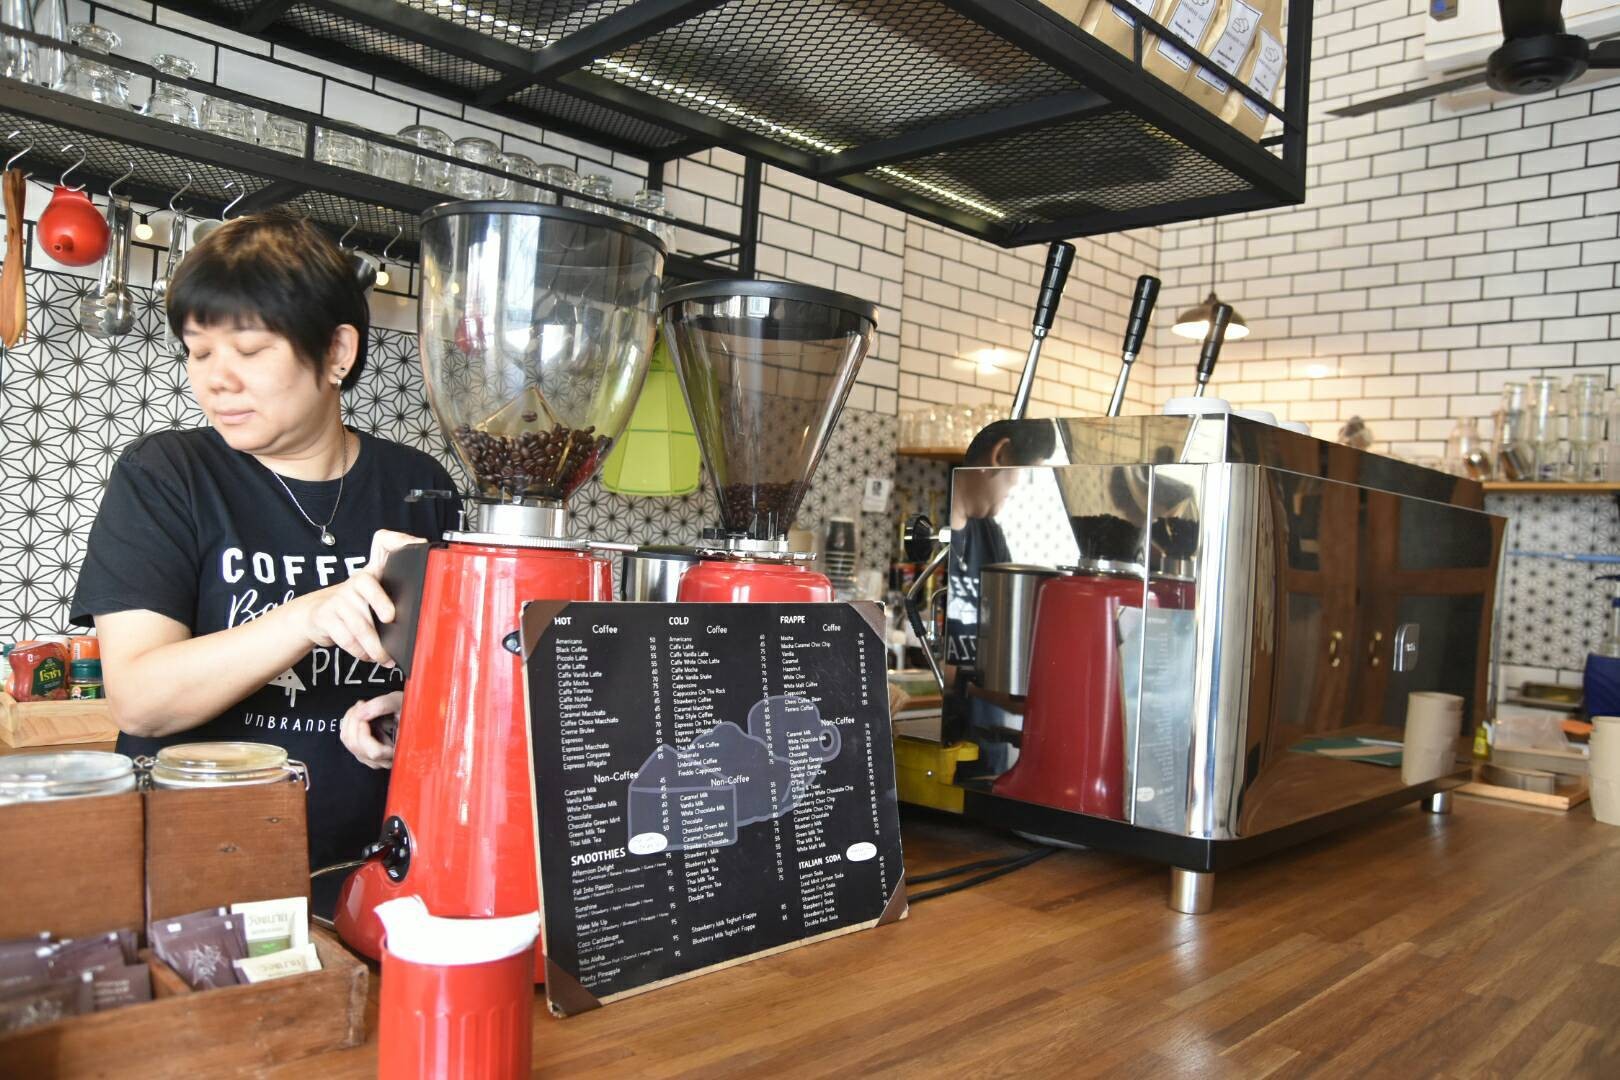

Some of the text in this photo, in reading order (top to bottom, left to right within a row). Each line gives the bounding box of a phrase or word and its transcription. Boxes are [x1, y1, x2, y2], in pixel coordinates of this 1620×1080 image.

[222, 547, 367, 586] COFFE
[669, 617, 689, 625] COLD
[592, 625, 617, 633] Coffee
[707, 625, 727, 633] Coffee
[244, 712, 342, 732] UNBRANDE
[821, 717, 855, 727] Non-Coffee
[594, 771, 638, 783] Non-Coffee
[711, 774, 749, 787] Non-Coffee
[571, 848, 626, 866] SMOOTHIES
[799, 854, 841, 869] ITALIAN SODA
[597, 864, 614, 872] Delight
[573, 888, 582, 896] Fall
[575, 904, 597, 913] Sunshine
